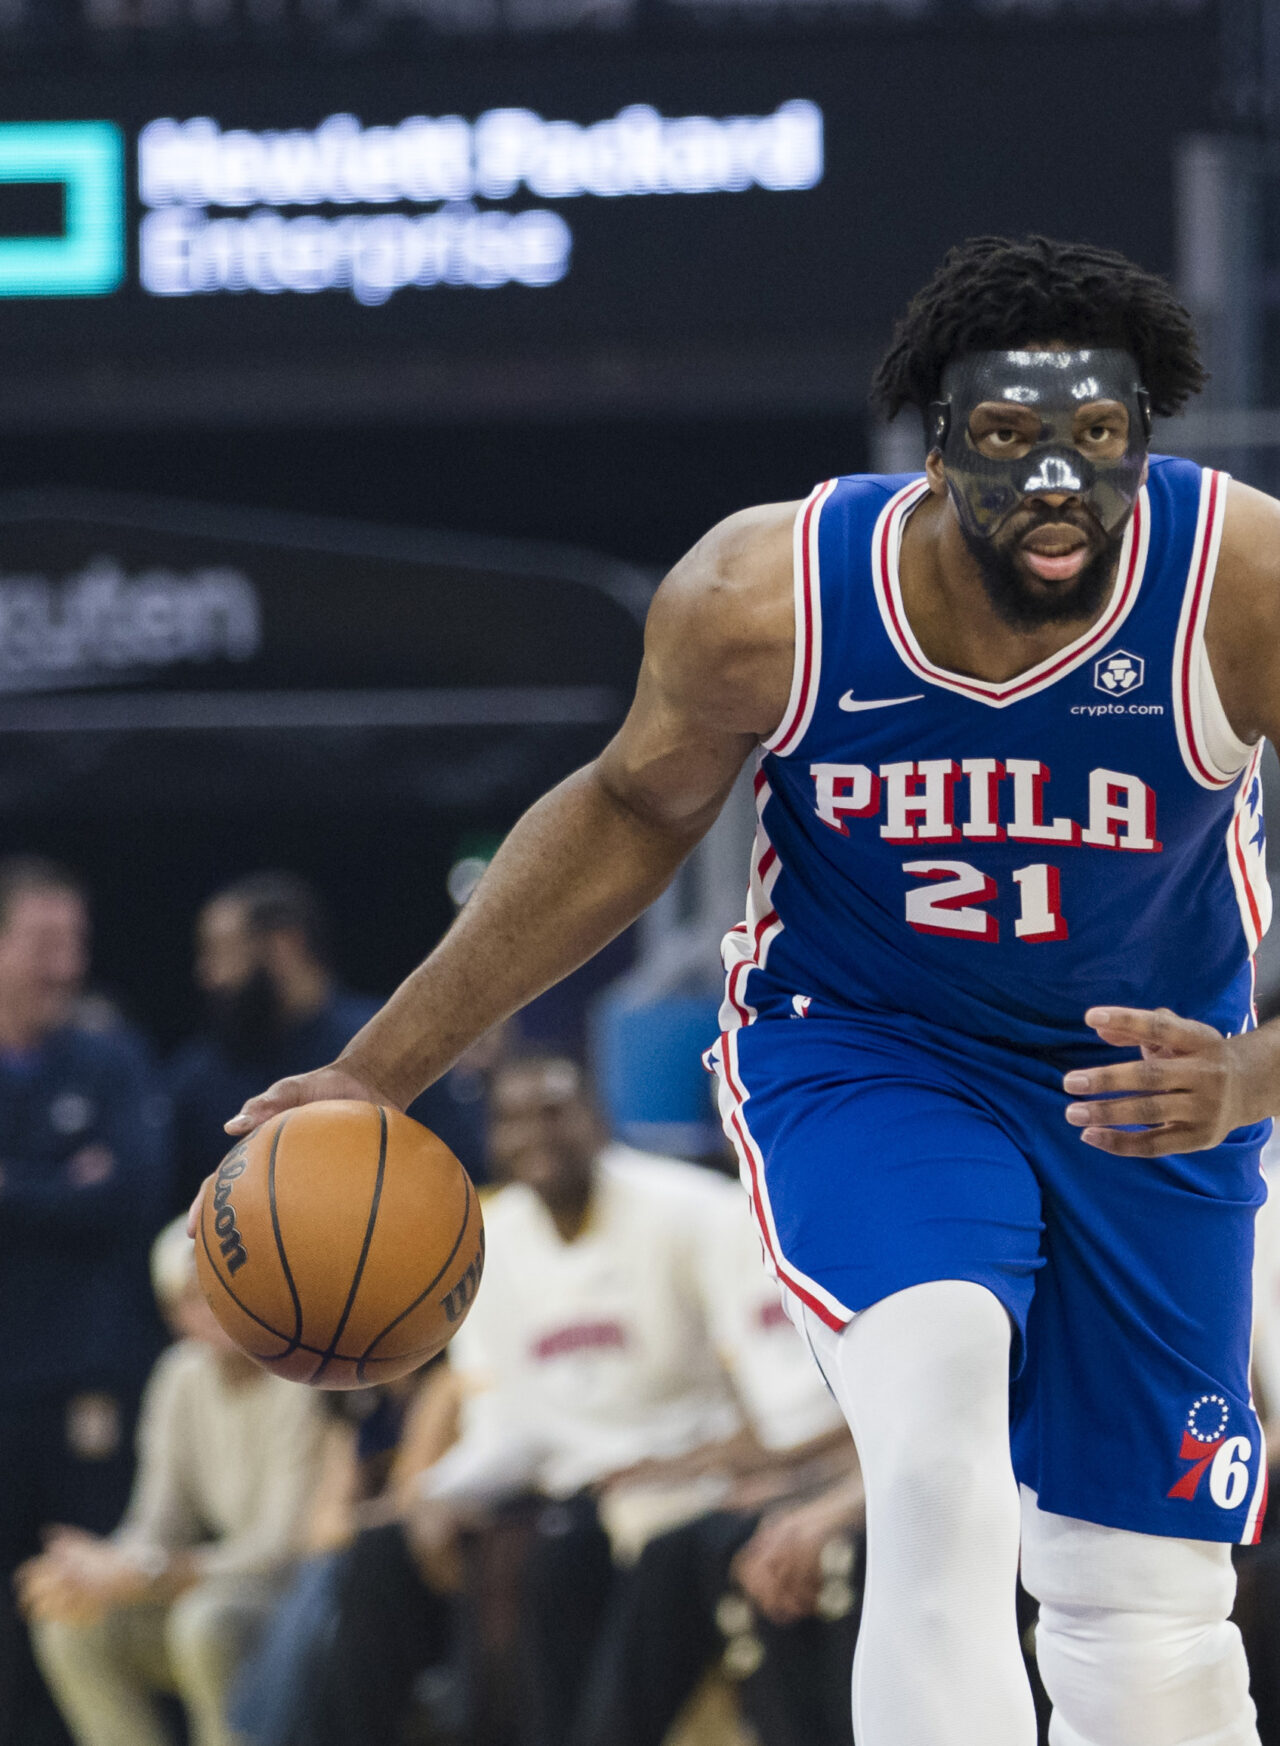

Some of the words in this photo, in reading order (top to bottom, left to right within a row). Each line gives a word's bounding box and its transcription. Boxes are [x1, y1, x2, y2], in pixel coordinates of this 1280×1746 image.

[138, 116, 473, 207] Hewlett
[475, 107, 824, 199] Packard
[139, 202, 572, 305] Enterprise
[1070, 703, 1164, 716] crypto.com
[809, 758, 1163, 853] PHILA
[902, 860, 1069, 944] 21
[1166, 1430, 1252, 1510] 76
